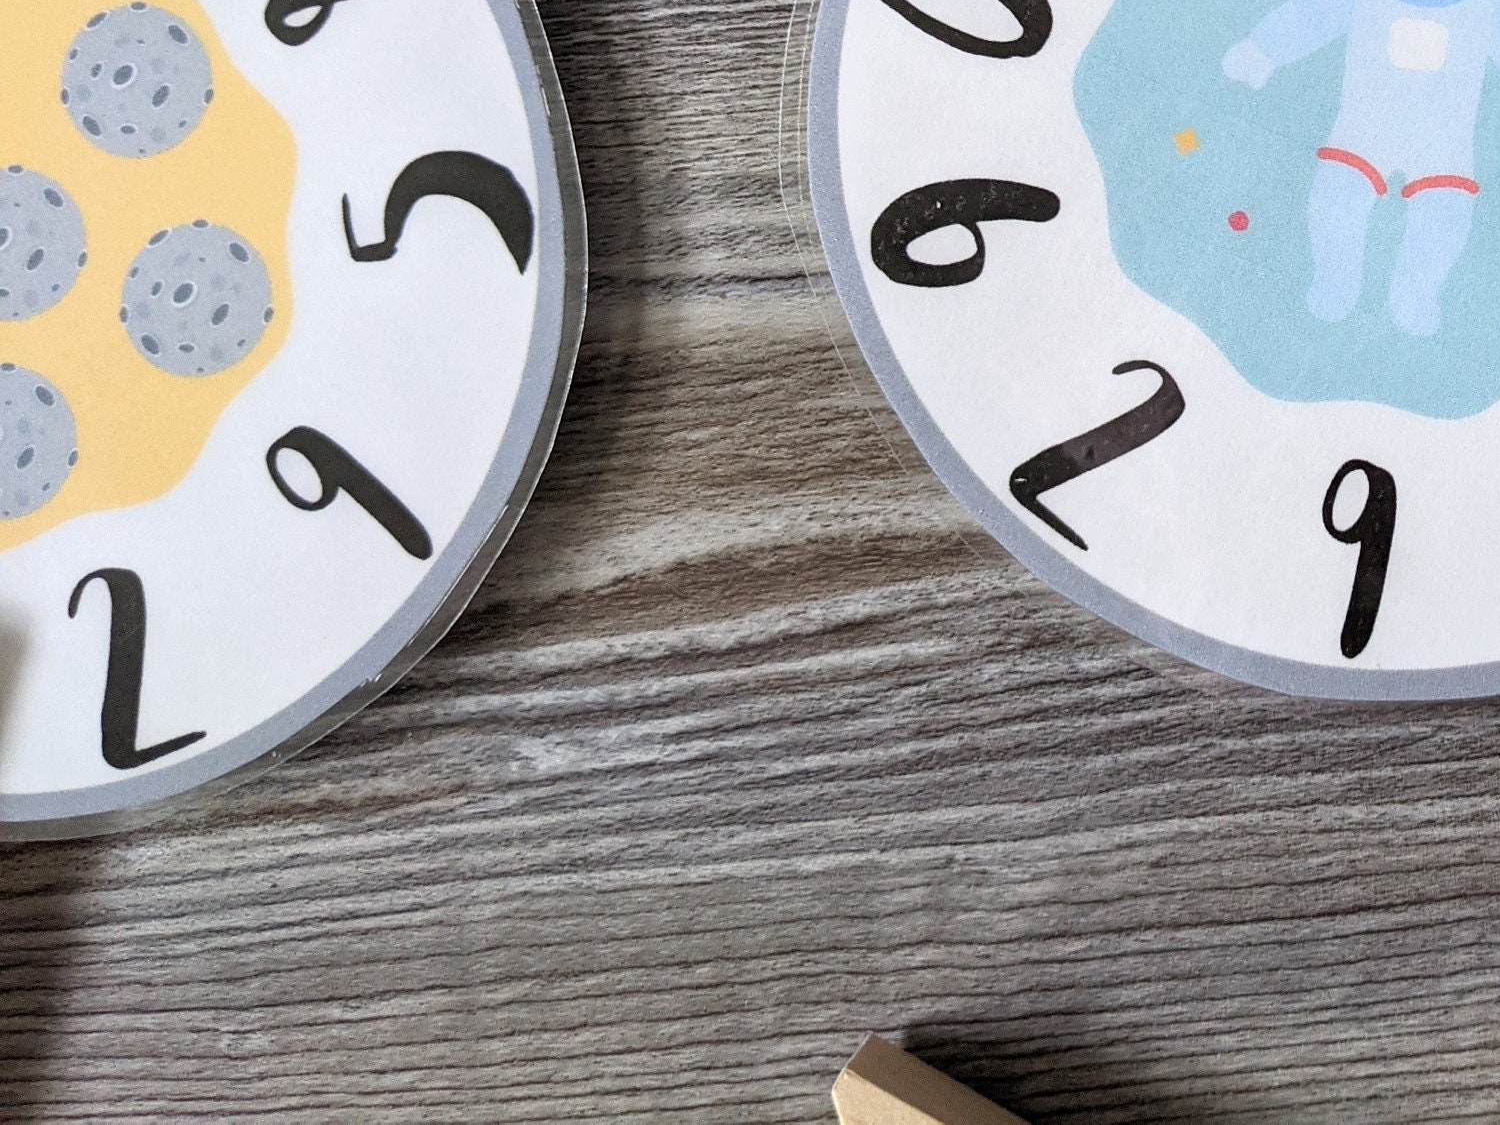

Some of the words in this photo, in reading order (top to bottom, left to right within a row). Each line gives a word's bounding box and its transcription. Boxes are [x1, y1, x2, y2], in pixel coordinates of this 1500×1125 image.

[342, 150, 535, 275] 5
[870, 178, 1061, 288] 6
[265, 426, 432, 561] 9
[1009, 359, 1186, 551] 2
[1322, 459, 1398, 660] 9
[68, 567, 206, 770] 2
